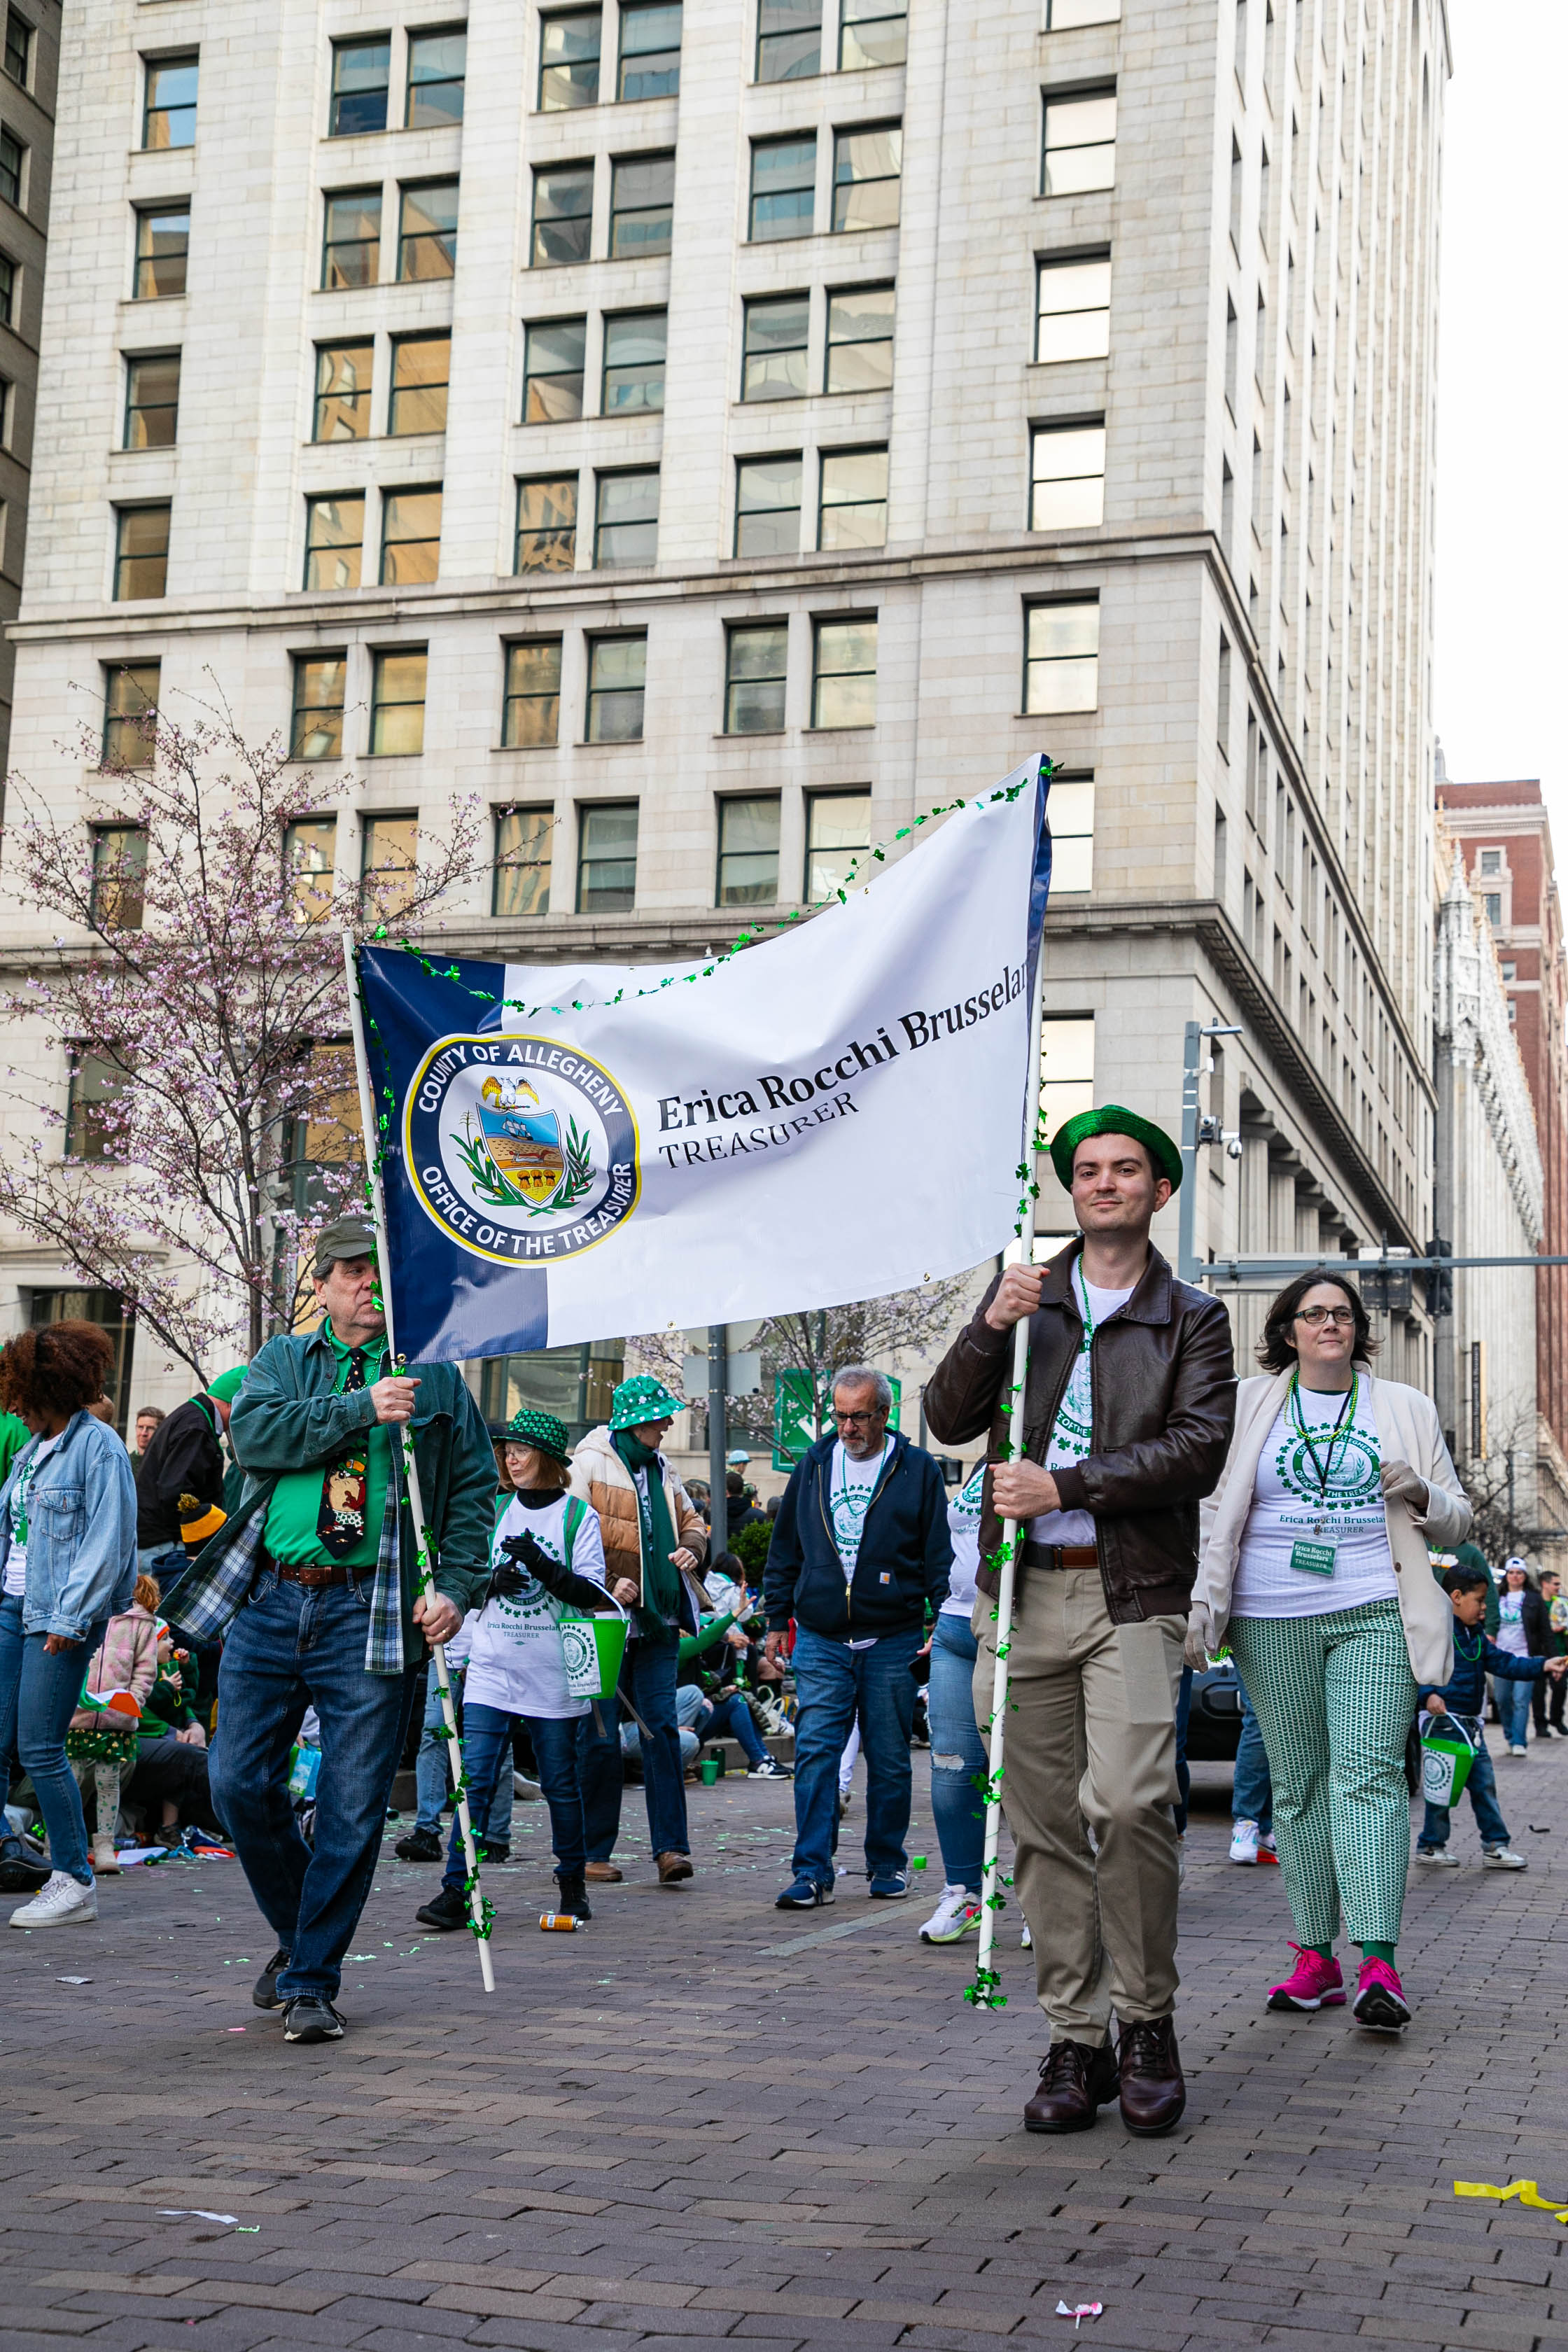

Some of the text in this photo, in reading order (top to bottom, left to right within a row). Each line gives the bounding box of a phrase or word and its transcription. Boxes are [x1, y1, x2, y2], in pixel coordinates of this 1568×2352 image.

[419, 1044, 624, 1117] COUNTY OF ALLEGHENY
[657, 1088, 761, 1132] Erica
[757, 1027, 900, 1110] Rocchi
[659, 1091, 860, 1170] TREASURER
[422, 1162, 632, 1255] OFFICE OF THE TREASURER
[1338, 1436, 1376, 1457] LLEGHENY
[1295, 1469, 1316, 1489] OFFICE
[1343, 1470, 1380, 1497] TREASURER
[831, 1497, 847, 1512] COUNT
[1280, 1514, 1303, 1524] Erica
[1295, 1544, 1332, 1556] Erica Rocchi
[1295, 1550, 1329, 1562] Brusselars
[1294, 1558, 1327, 1569] TREASURER
